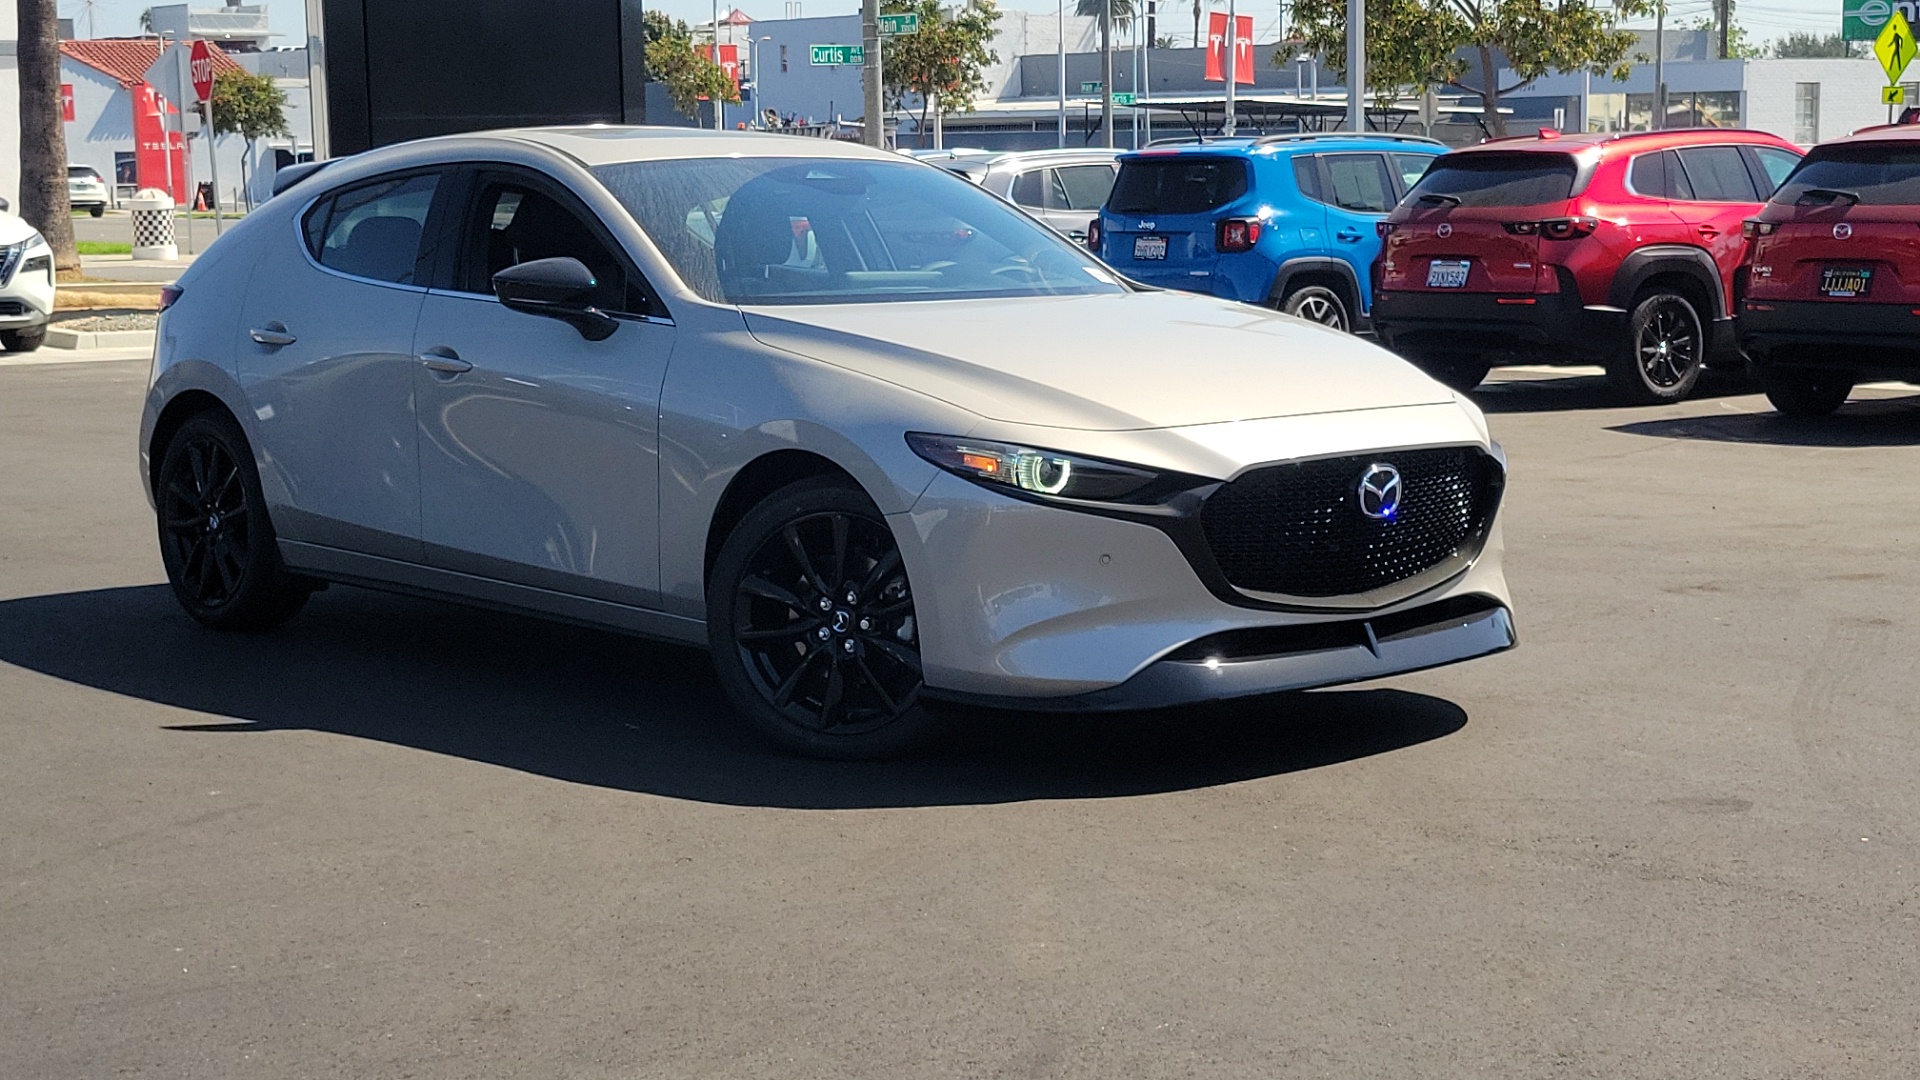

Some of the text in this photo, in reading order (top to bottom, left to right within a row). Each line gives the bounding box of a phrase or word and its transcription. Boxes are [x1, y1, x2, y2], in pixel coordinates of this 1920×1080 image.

[878, 19, 897, 32] Main
[812, 47, 844, 63] Curtis
[191, 58, 212, 83] STOP
[1138, 220, 1156, 230] Jeep
